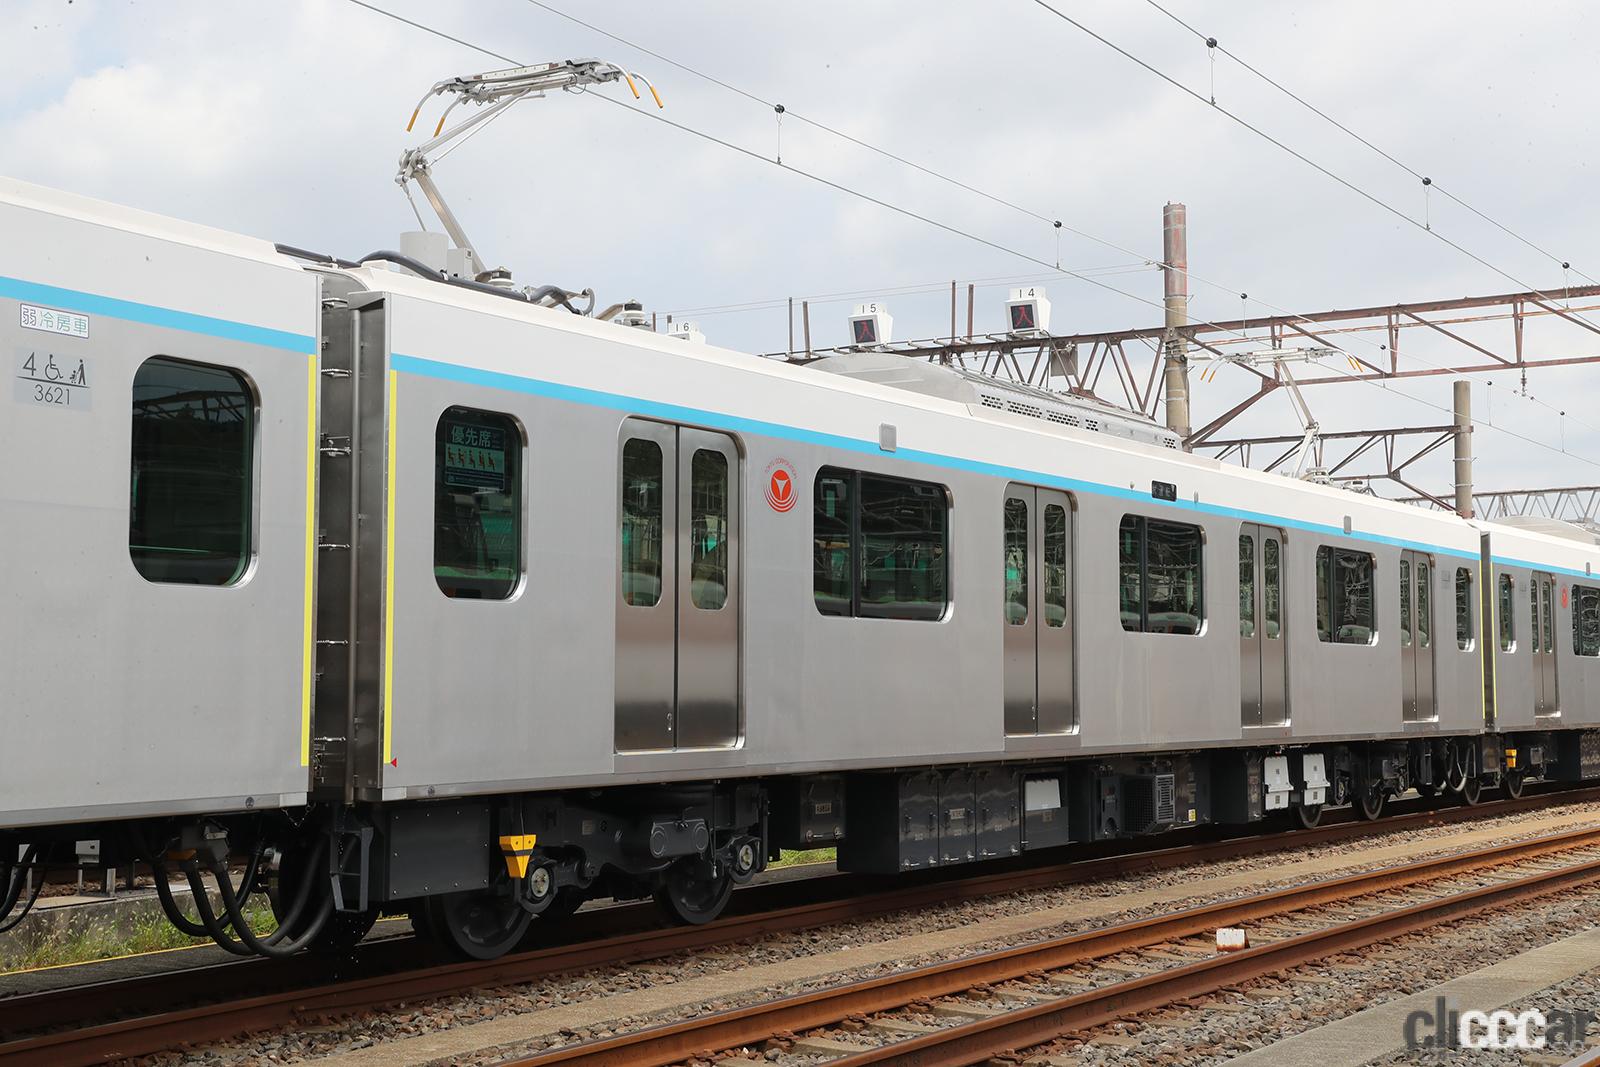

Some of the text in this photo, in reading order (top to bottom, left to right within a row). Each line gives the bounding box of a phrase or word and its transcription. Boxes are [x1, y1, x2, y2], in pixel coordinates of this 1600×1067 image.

[1019, 288, 1035, 299] 14
[862, 303, 877, 314] 15
[22, 307, 88, 335] 弱冷房車
[675, 322, 690, 332] 16
[22, 351, 37, 377] 4
[34, 383, 70, 405] 3621
[451, 424, 493, 448] 優先席
